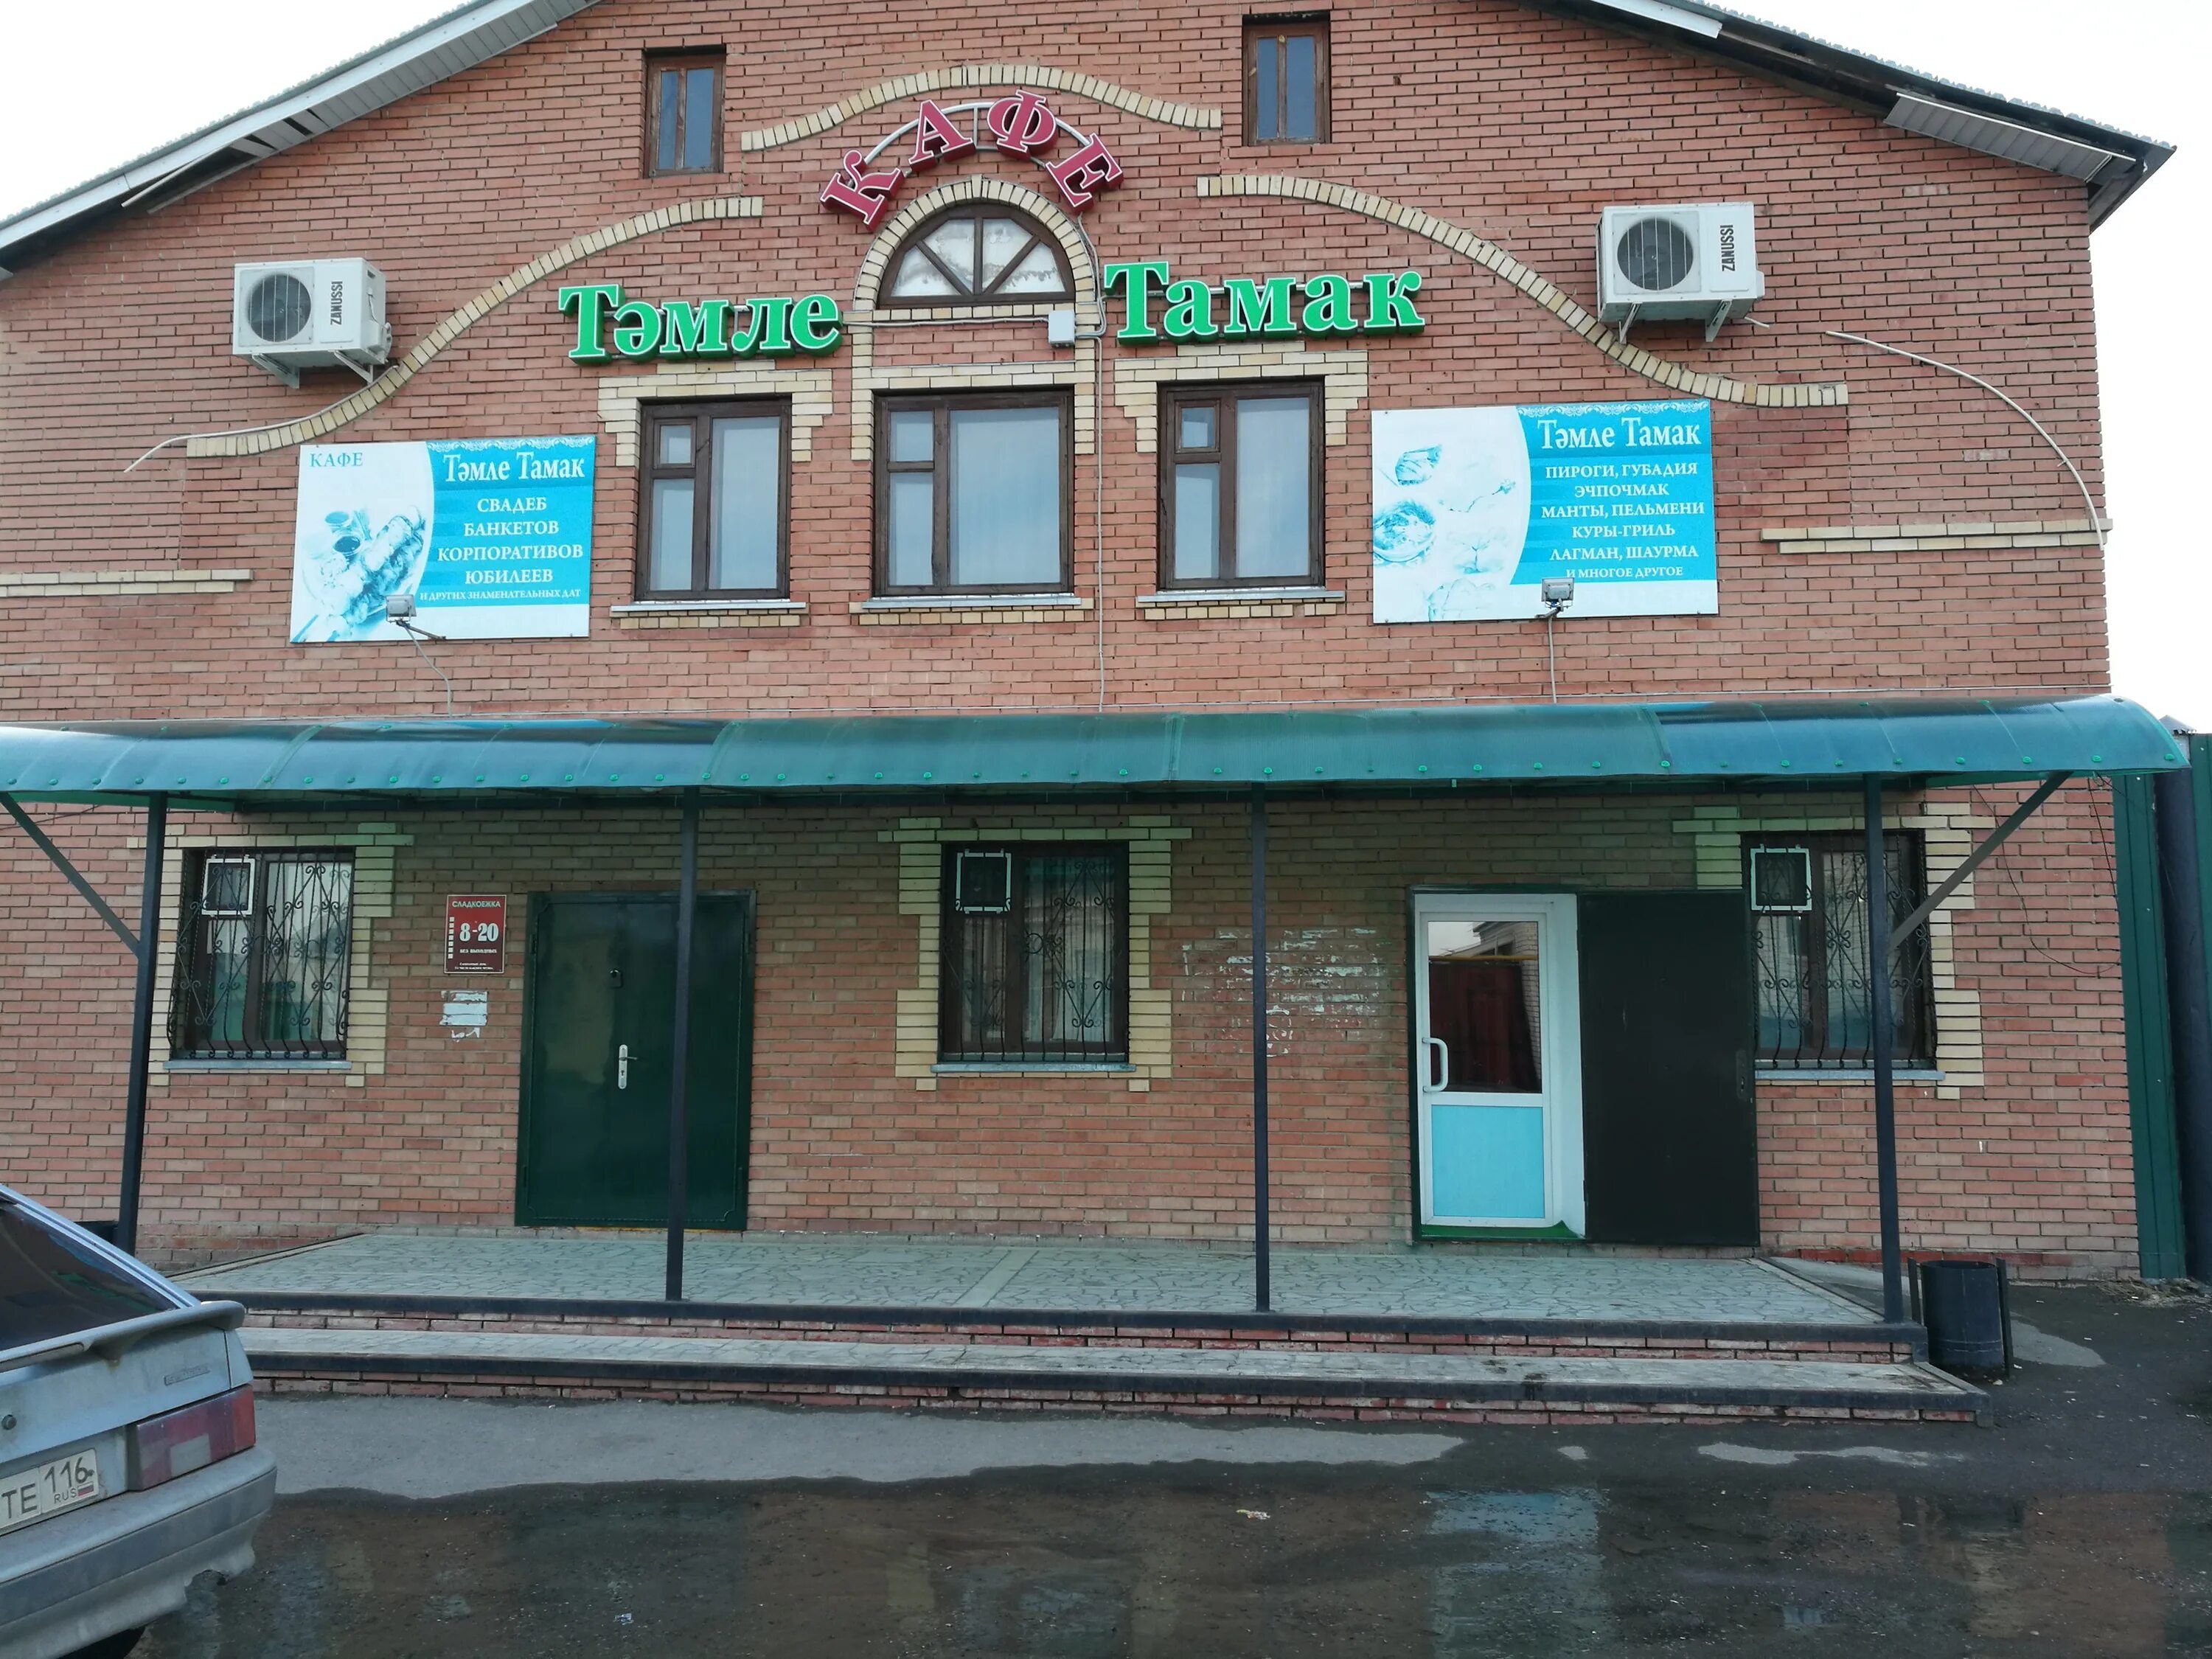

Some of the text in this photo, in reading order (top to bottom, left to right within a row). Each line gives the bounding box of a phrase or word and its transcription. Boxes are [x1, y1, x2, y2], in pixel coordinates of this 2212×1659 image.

[819, 89, 1124, 229] КАФЕ
[1719, 224, 1736, 272] ZANUSSI
[330, 280, 343, 325] ZANUSSI
[558, 261, 1425, 361] Тәмле Тамак
[1537, 416, 1701, 451] Тәмле Тамак
[310, 452, 364, 467] КАФЕ
[442, 451, 585, 483] Тәмле Тамак
[1545, 462, 1697, 480] ПИРОГИ, ГУБАДИЯ
[1574, 484, 1669, 498] ЭЧПОЧМАК
[476, 497, 547, 514] СВАДЕБ
[1541, 502, 1705, 521] МАНТЫ, ПЕЛЬМЕНИ
[463, 520, 559, 537] БАНКЕТОВ
[1572, 524, 1676, 540] КУРЫ-ГРИЛЬ
[437, 544, 583, 562] КОРПОРАТИВОВ
[1550, 545, 1700, 563] ЛАГМАН, ШАУРМА
[465, 568, 553, 585] ЮБИЛЕЕВ
[1566, 566, 1683, 580] И МНОГОЕ ДРУГОЕ
[420, 589, 581, 602] И ДРУГИХ ЗНАМЕНАТЕЛЬНЫХ ДАТ
[45, 1457, 89, 1493] 116
[54, 1488, 77, 1504] RUS
